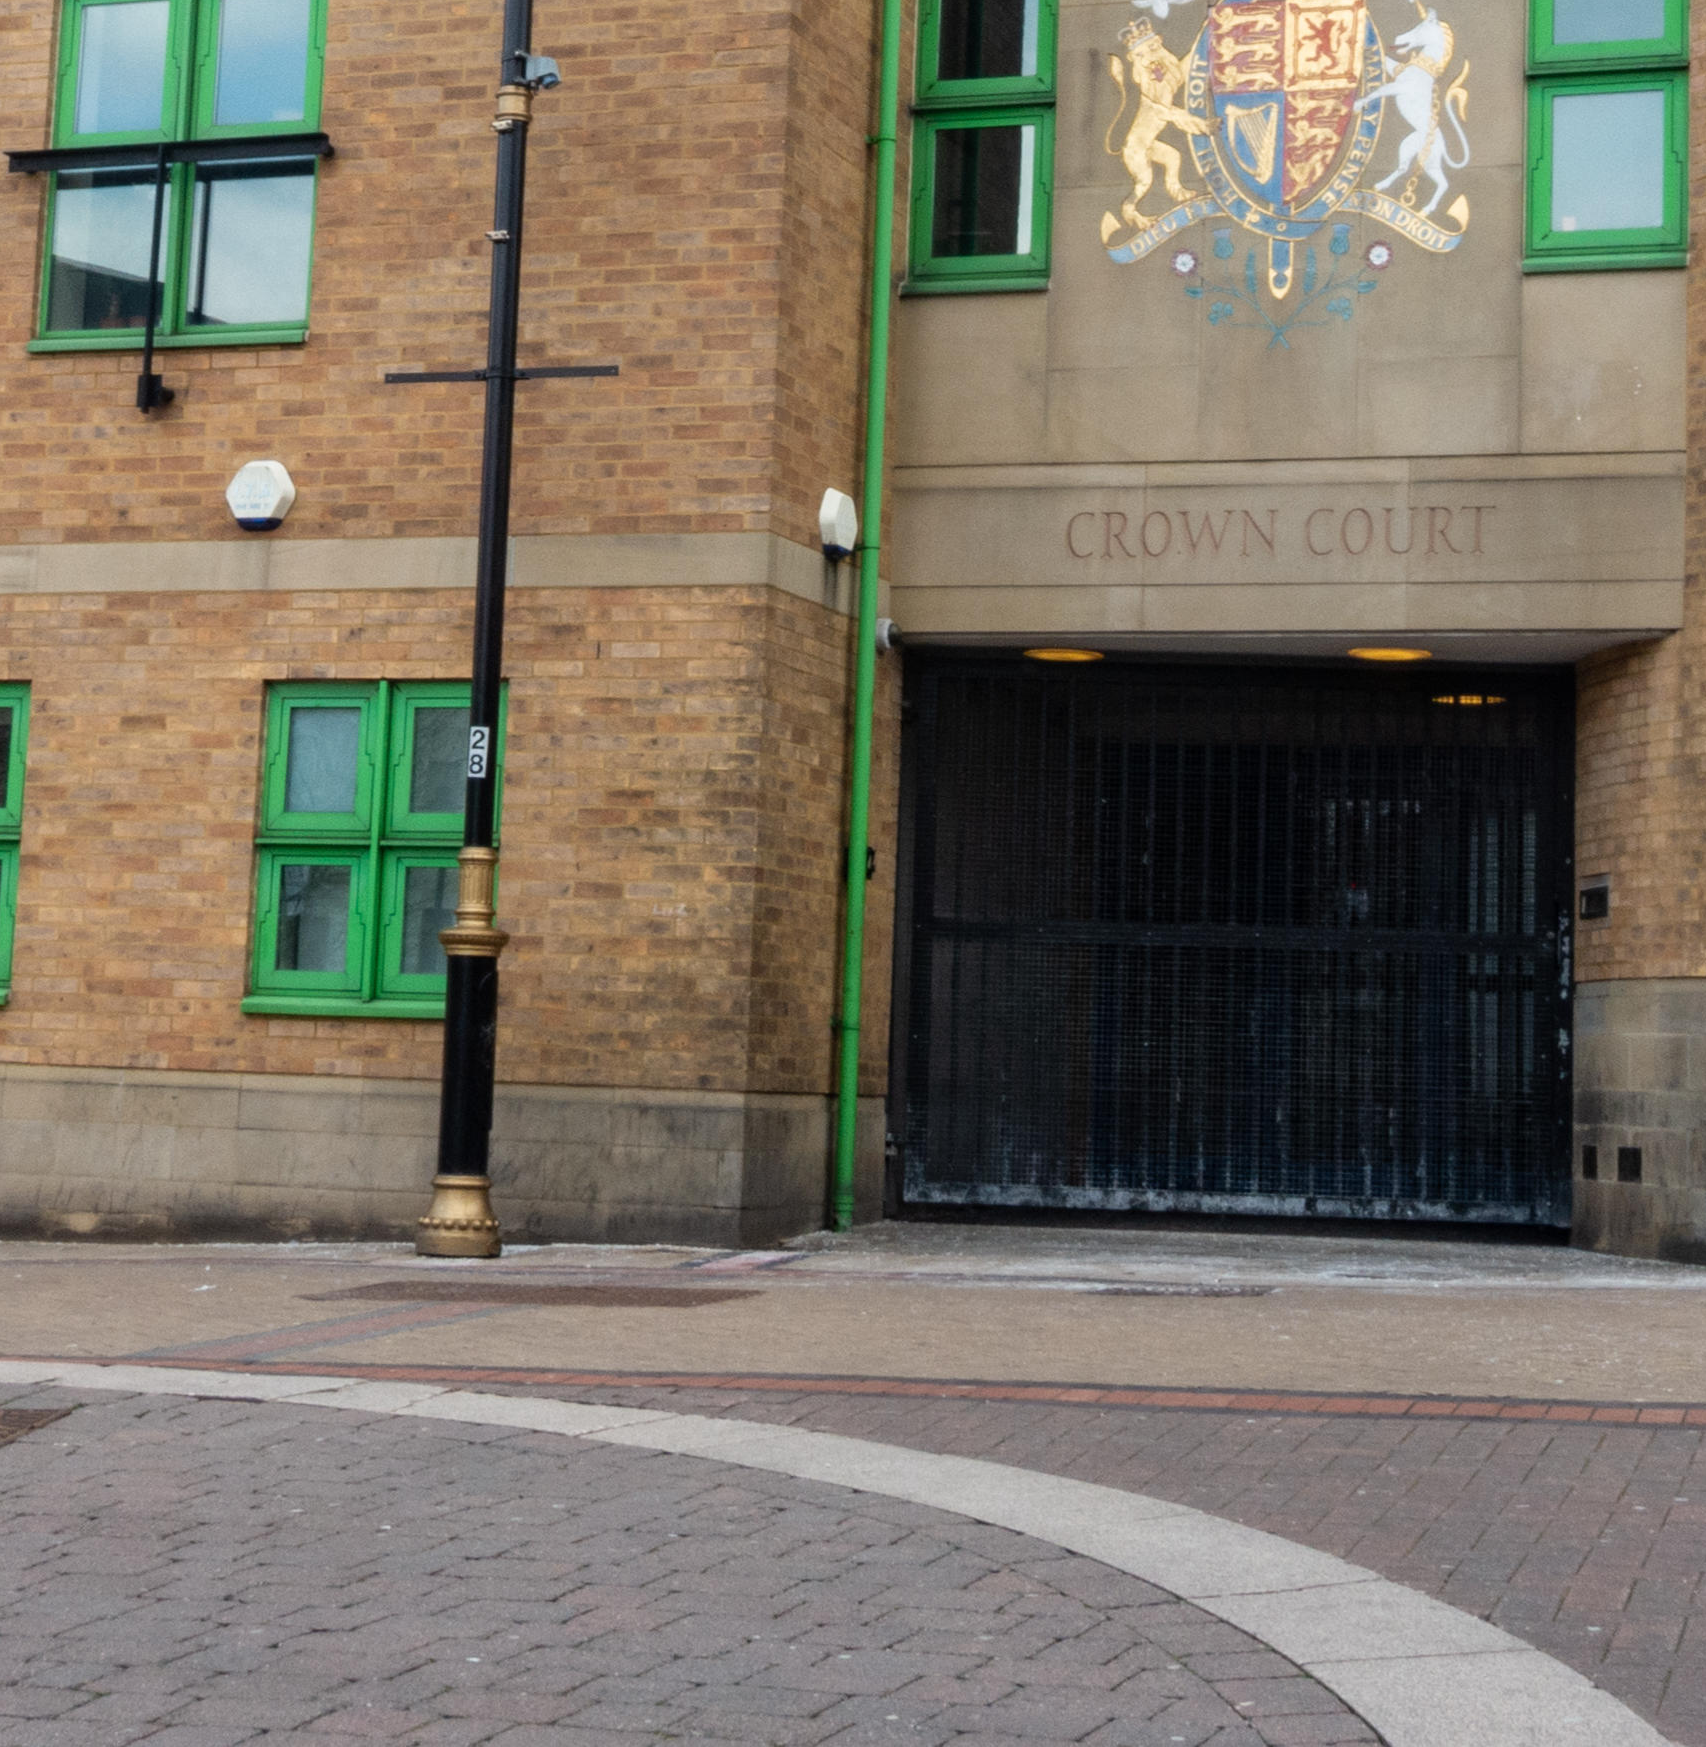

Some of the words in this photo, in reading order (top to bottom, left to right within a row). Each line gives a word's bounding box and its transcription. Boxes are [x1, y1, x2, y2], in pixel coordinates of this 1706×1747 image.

[1190, 54, 1208, 108] SOIT
[1321, 136, 1372, 208] PENSE
[1395, 211, 1451, 250] DROIT
[1066, 507, 1279, 560] CROWN
[1305, 505, 1497, 557] COURT
